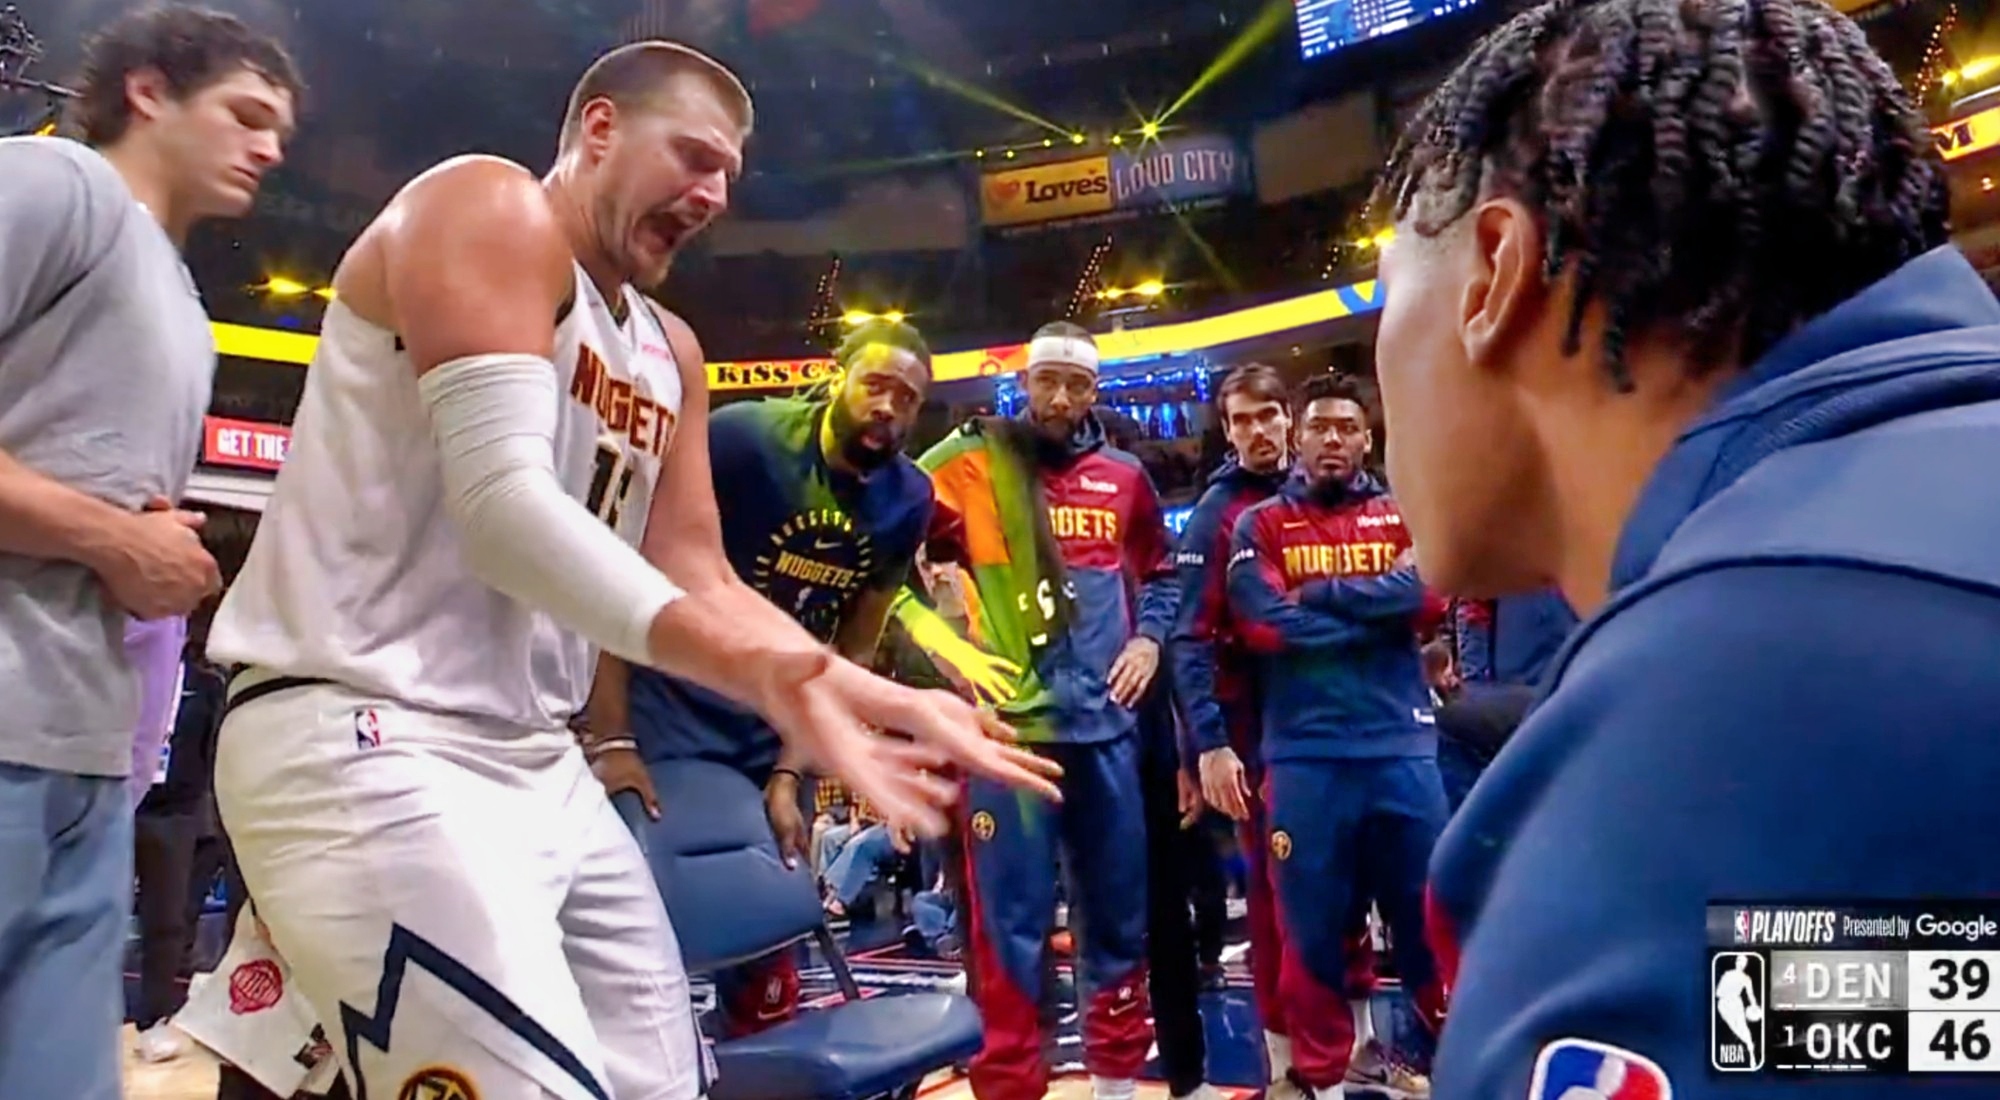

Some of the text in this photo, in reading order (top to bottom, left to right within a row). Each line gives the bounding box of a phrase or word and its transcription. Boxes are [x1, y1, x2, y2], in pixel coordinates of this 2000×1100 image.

[1115, 149, 1235, 201] LOUD CITY
[217, 427, 287, 462] GET THE
[1048, 505, 1118, 542] GETS
[774, 550, 855, 588] NUGGETS
